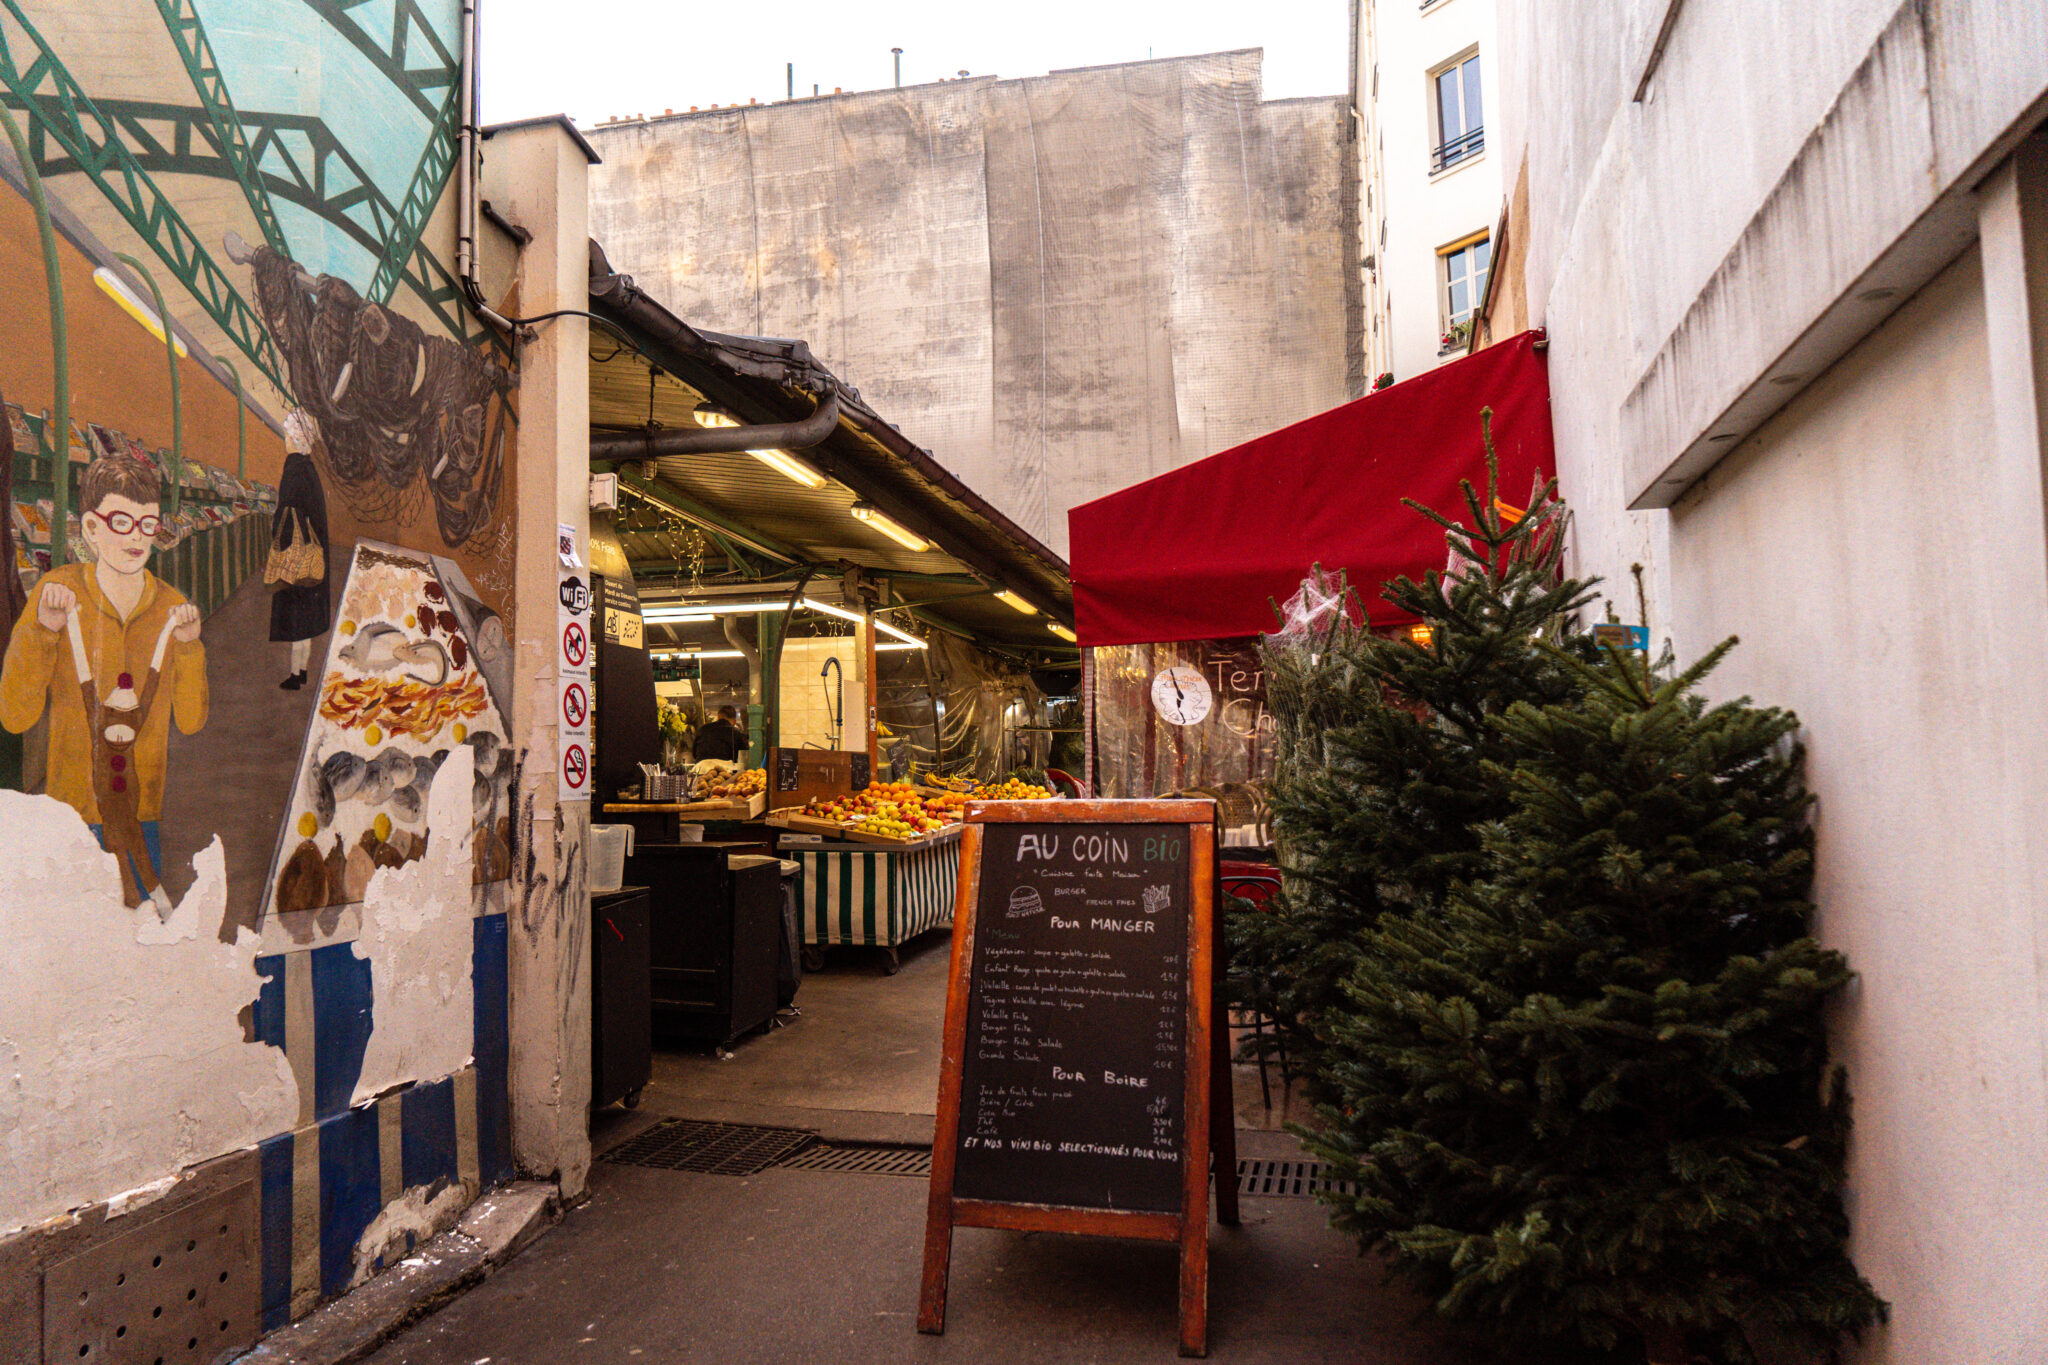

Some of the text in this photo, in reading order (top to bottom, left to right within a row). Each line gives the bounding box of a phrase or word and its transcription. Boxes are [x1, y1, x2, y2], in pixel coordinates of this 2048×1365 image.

[1016, 834, 1059, 862] AU
[1054, 887, 1087, 896] BURGER
[1091, 918, 1155, 933] MANGER
[980, 1085, 993, 1096] Jus
[977, 1127, 998, 1135] Café
[964, 1136, 979, 1148] ET
[984, 1138, 1002, 1149] NOS
